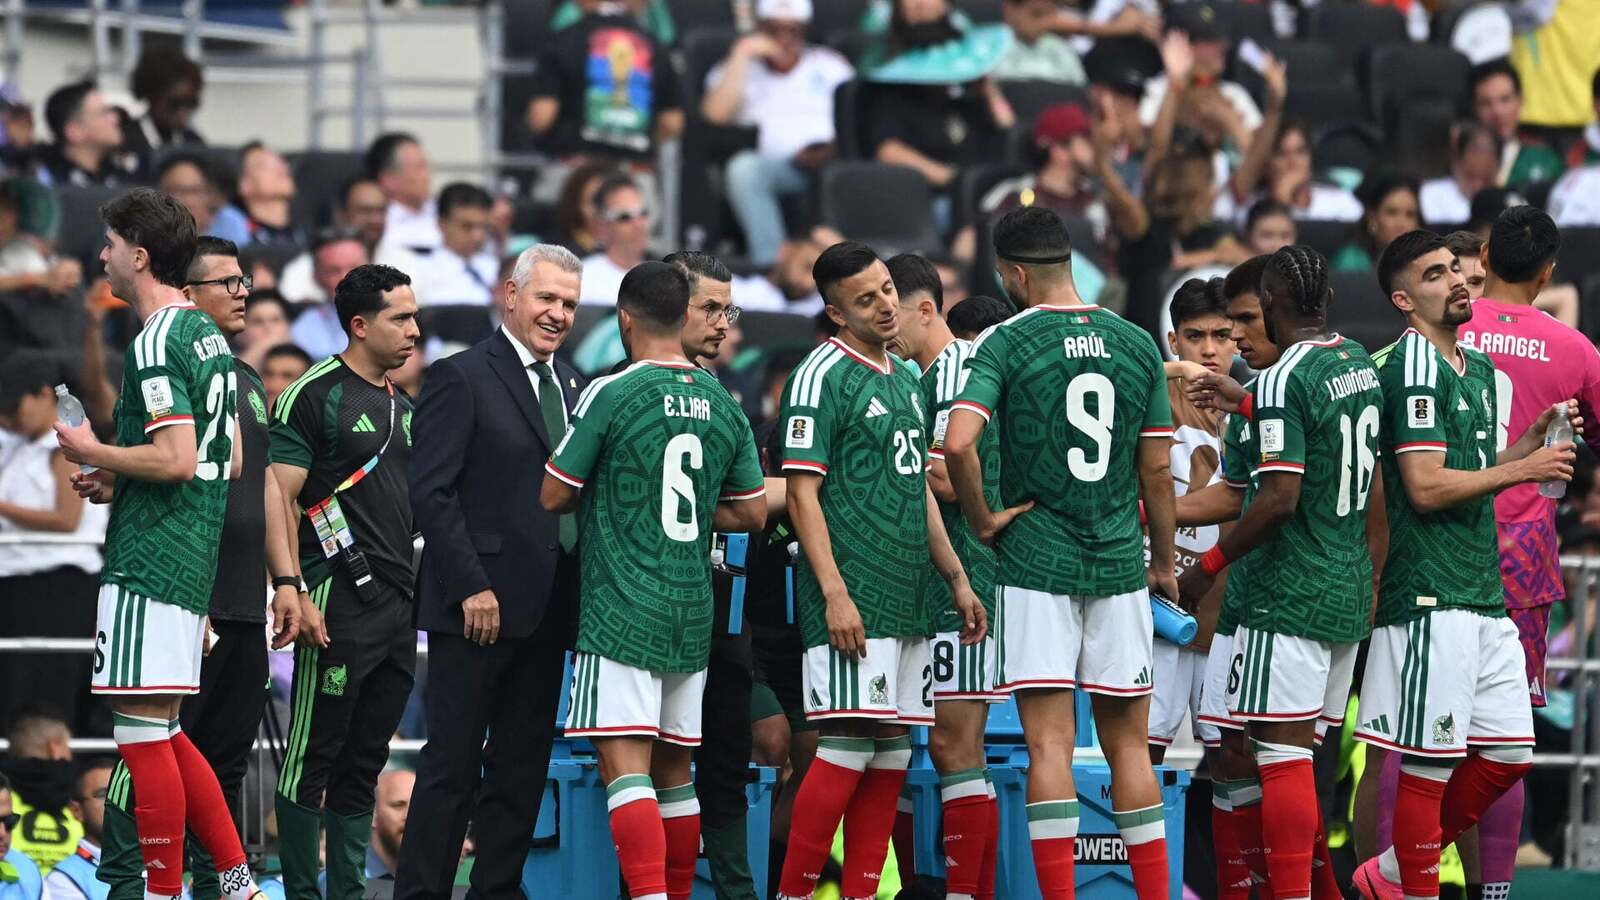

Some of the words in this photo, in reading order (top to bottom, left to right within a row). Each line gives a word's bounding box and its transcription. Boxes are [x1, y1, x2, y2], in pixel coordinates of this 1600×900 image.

[1063, 332, 1112, 359] RAÚL
[1464, 331, 1551, 362] RRANGEL
[664, 394, 711, 421] E.LIRA
[1066, 372, 1115, 482] 9
[893, 429, 922, 475] 25
[1336, 405, 1380, 517] 16
[661, 433, 703, 542] 6
[933, 640, 954, 683] 8
[1228, 653, 1244, 695] 6
[1073, 838, 1129, 861] OWER
